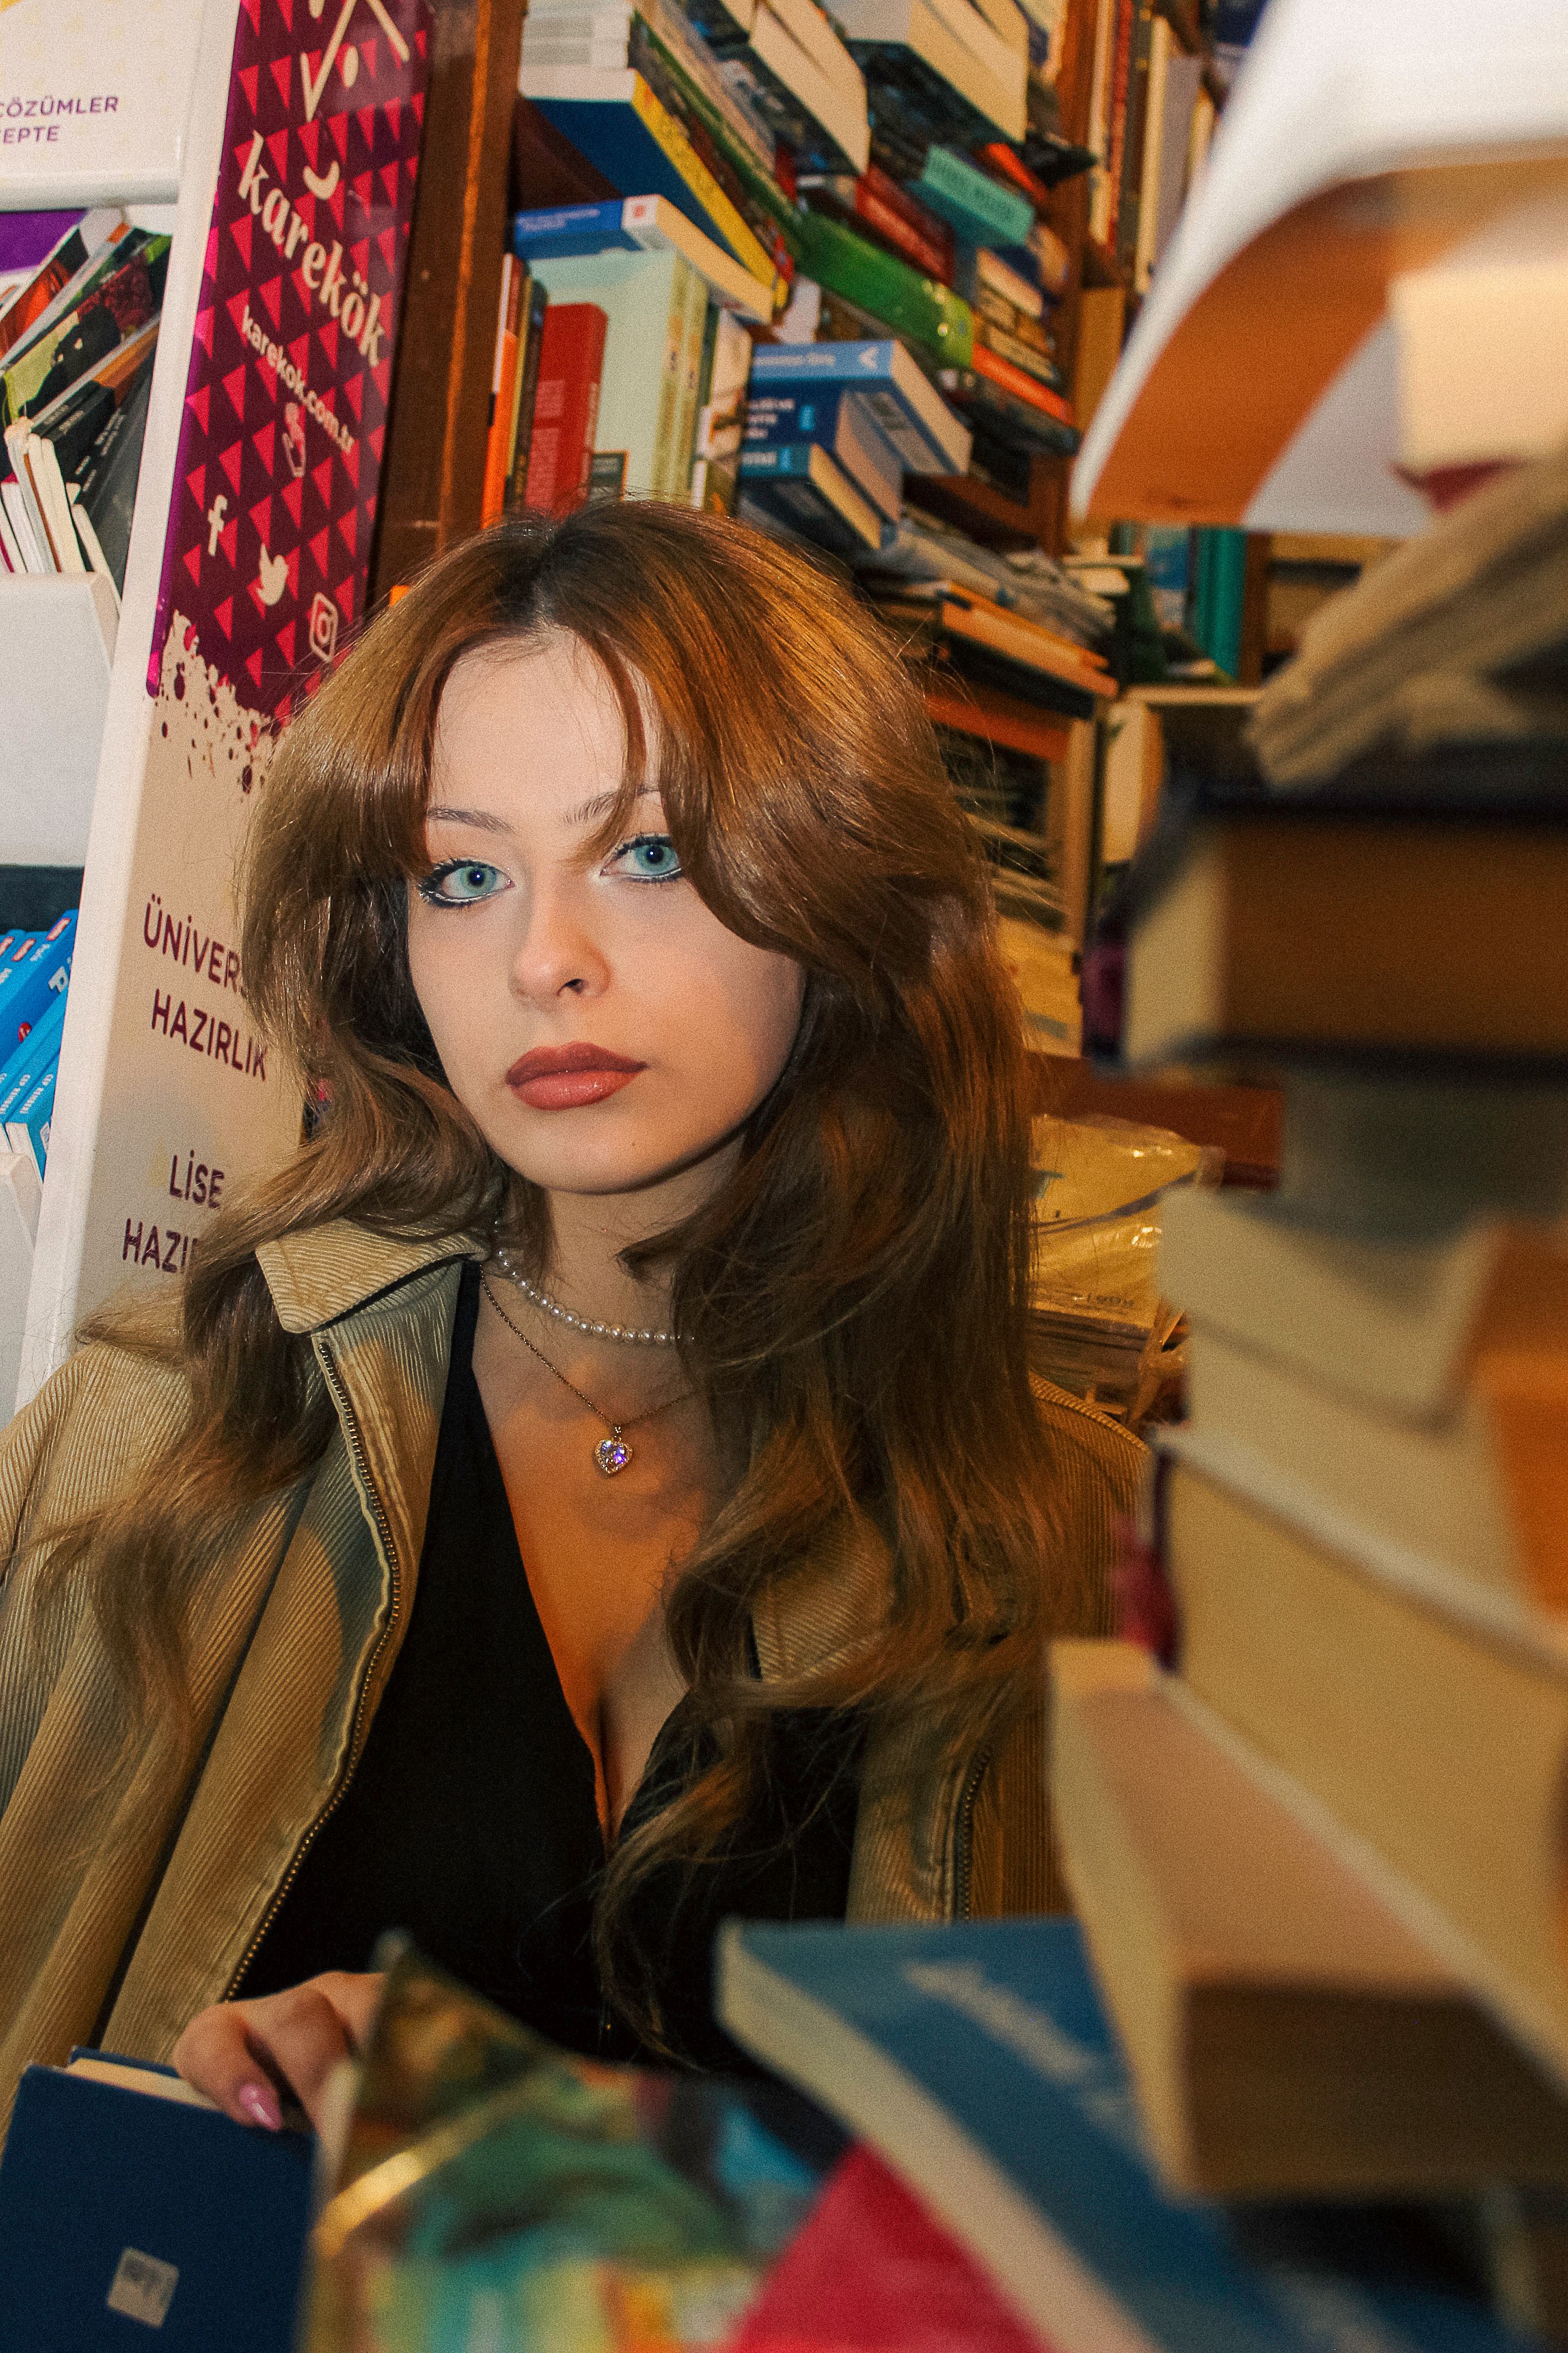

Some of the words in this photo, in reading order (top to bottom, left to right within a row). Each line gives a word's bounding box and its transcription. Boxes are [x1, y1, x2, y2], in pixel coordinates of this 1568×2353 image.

[0, 126, 60, 144] EPTE
[238, 129, 385, 368] karekök
[242, 305, 355, 453] karekok.com.tr
[144, 893, 249, 1003] ÜNİVER
[152, 988, 267, 1081] HAZIRLIK
[170, 1150, 225, 1209] LİSE
[122, 1218, 199, 1274] HAZI
